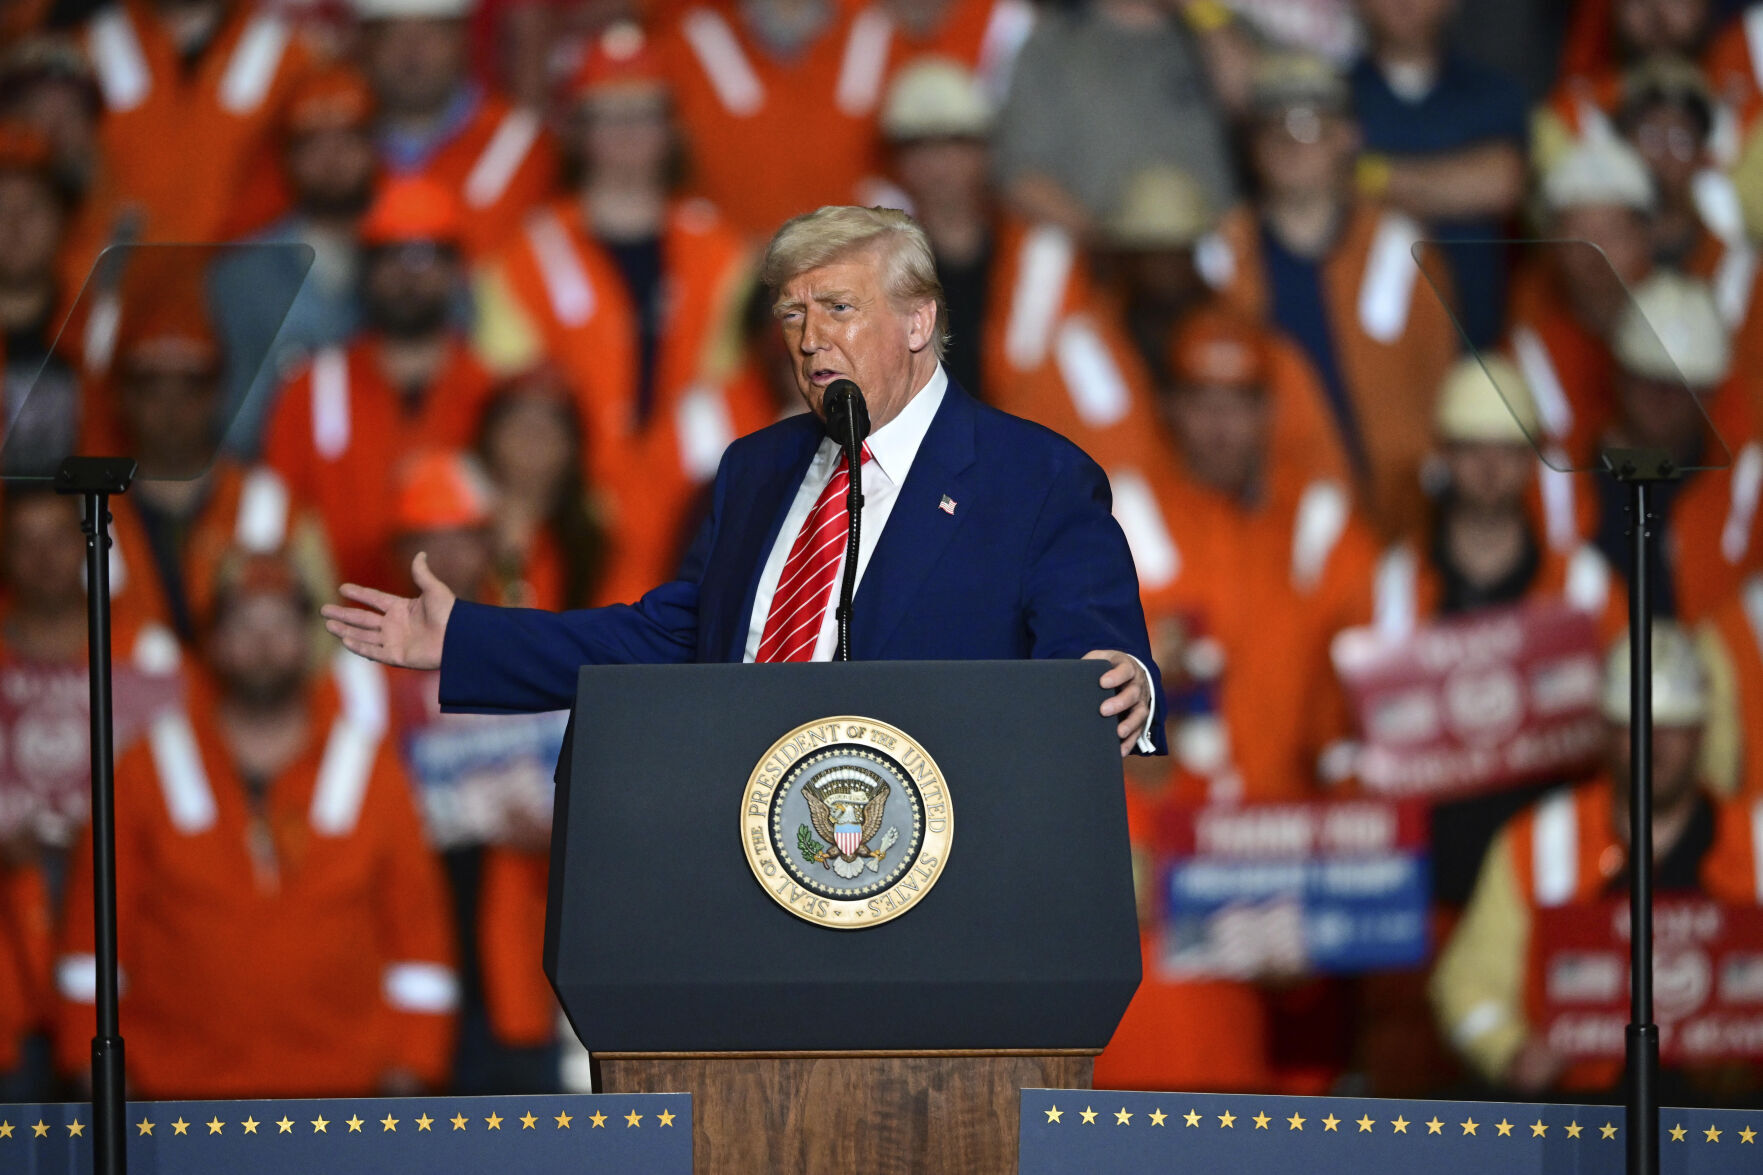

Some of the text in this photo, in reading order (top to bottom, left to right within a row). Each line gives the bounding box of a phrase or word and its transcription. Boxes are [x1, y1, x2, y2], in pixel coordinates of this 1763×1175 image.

[749, 724, 946, 918] SEAL OF THE PRESIDENT OF THE UNITED STATES
